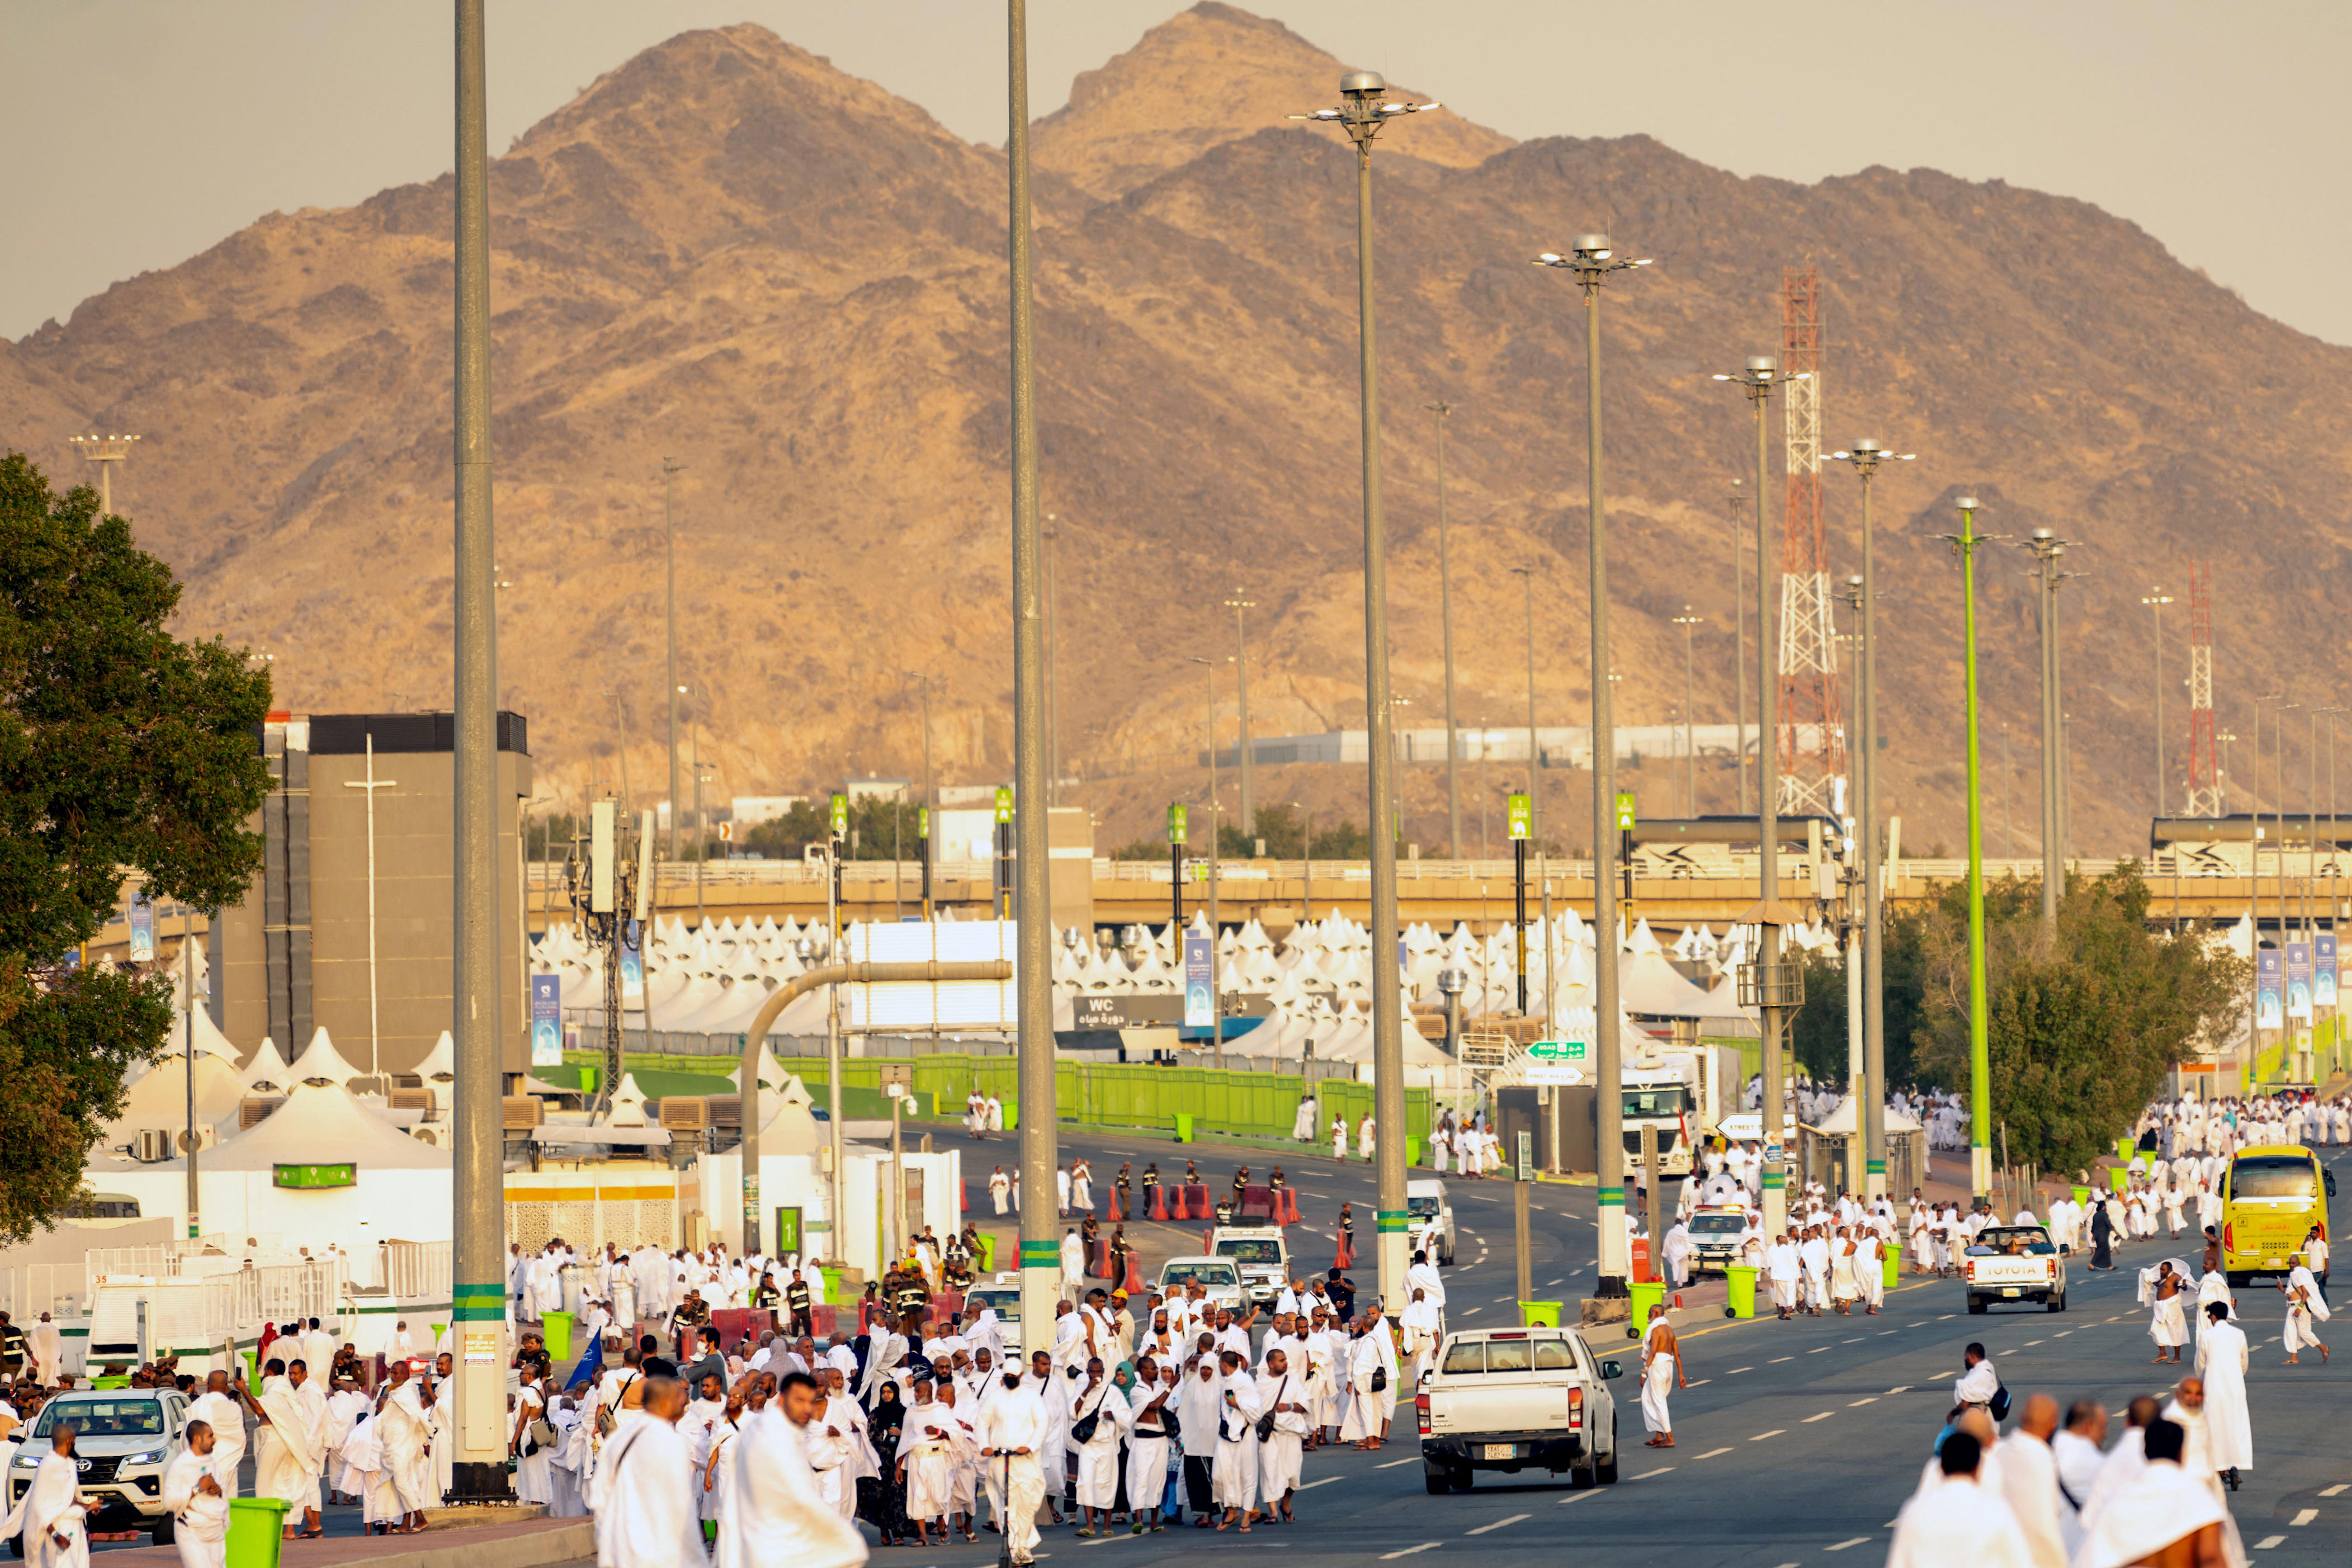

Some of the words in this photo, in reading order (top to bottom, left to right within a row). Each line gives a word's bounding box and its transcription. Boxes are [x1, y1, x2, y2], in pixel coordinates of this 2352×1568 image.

[1089, 999, 1114, 1012] WC
[1079, 1014, 1099, 1027] مياه
[1101, 1013, 1125, 1025] دورة
[1986, 1265, 2036, 1276] TOYOTA
[95, 1275, 107, 1283] 35
